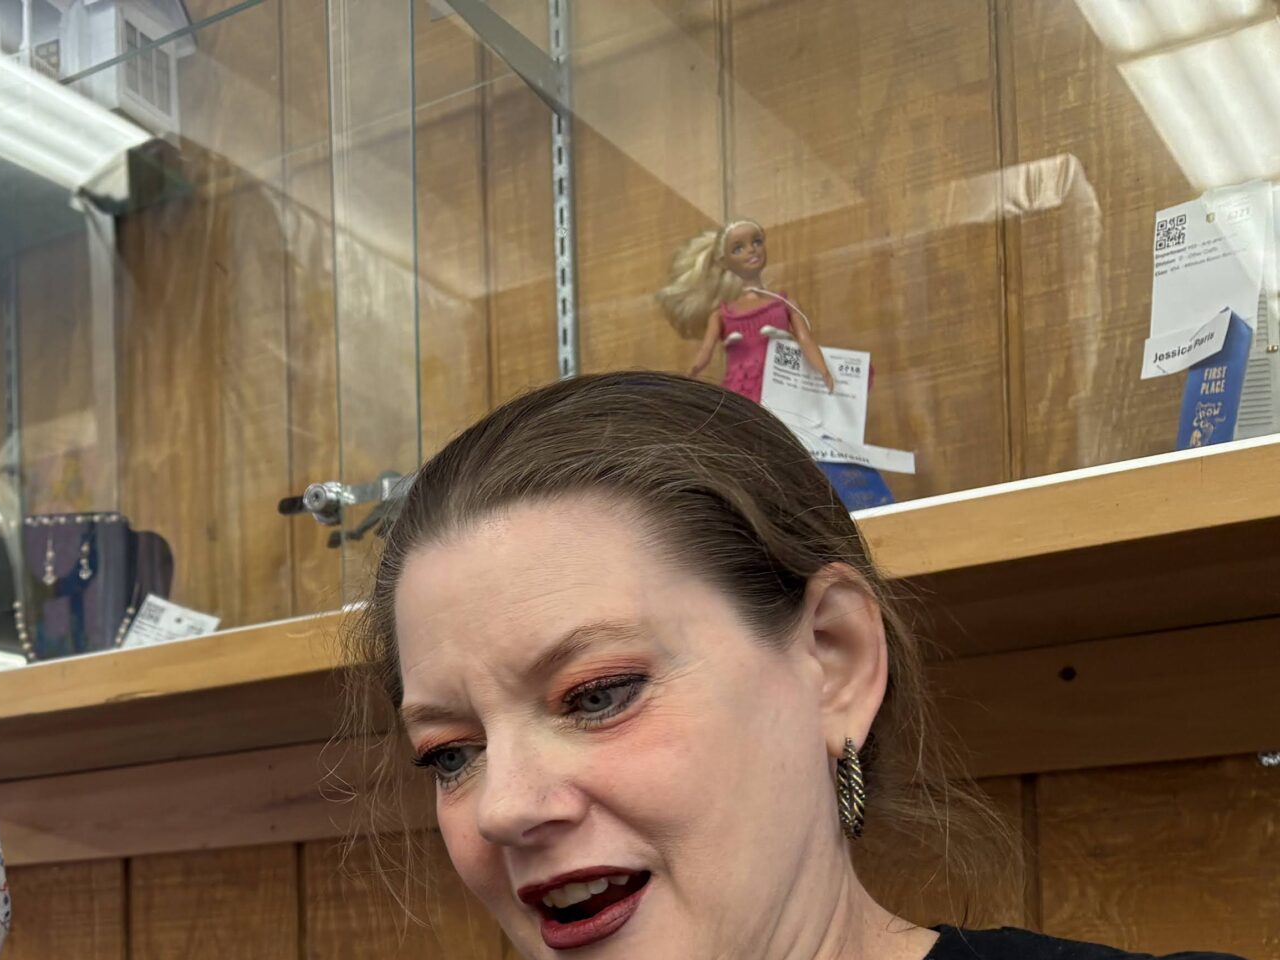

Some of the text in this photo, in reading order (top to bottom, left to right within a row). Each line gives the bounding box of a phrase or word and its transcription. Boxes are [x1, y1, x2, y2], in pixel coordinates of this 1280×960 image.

[1153, 331, 1215, 363] Jessica Paris
[1204, 366, 1228, 381] FIRST
[1200, 380, 1226, 395] PLACE
